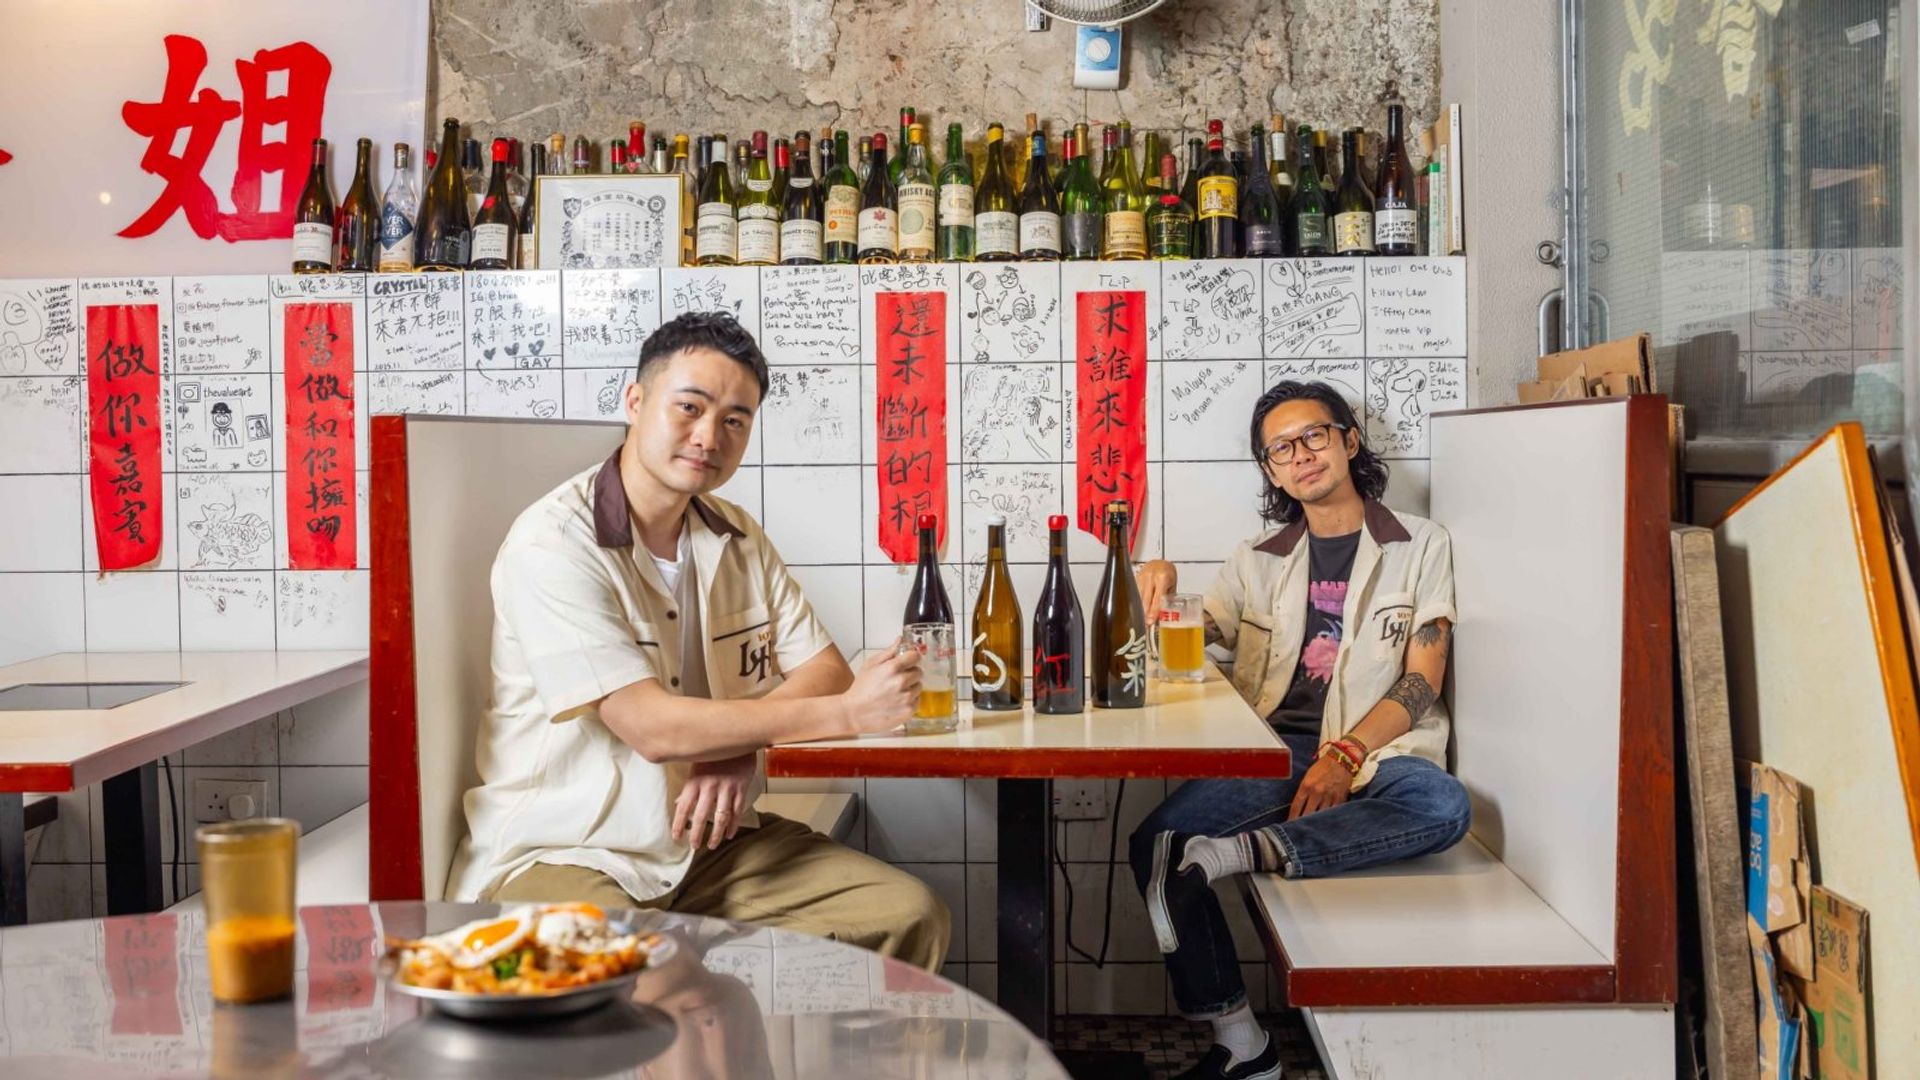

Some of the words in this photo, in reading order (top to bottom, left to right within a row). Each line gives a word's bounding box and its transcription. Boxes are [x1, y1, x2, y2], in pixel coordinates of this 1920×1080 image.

[97, 338, 156, 545] 做你嘉賓
[1171, 368, 1213, 401] Malaysia
